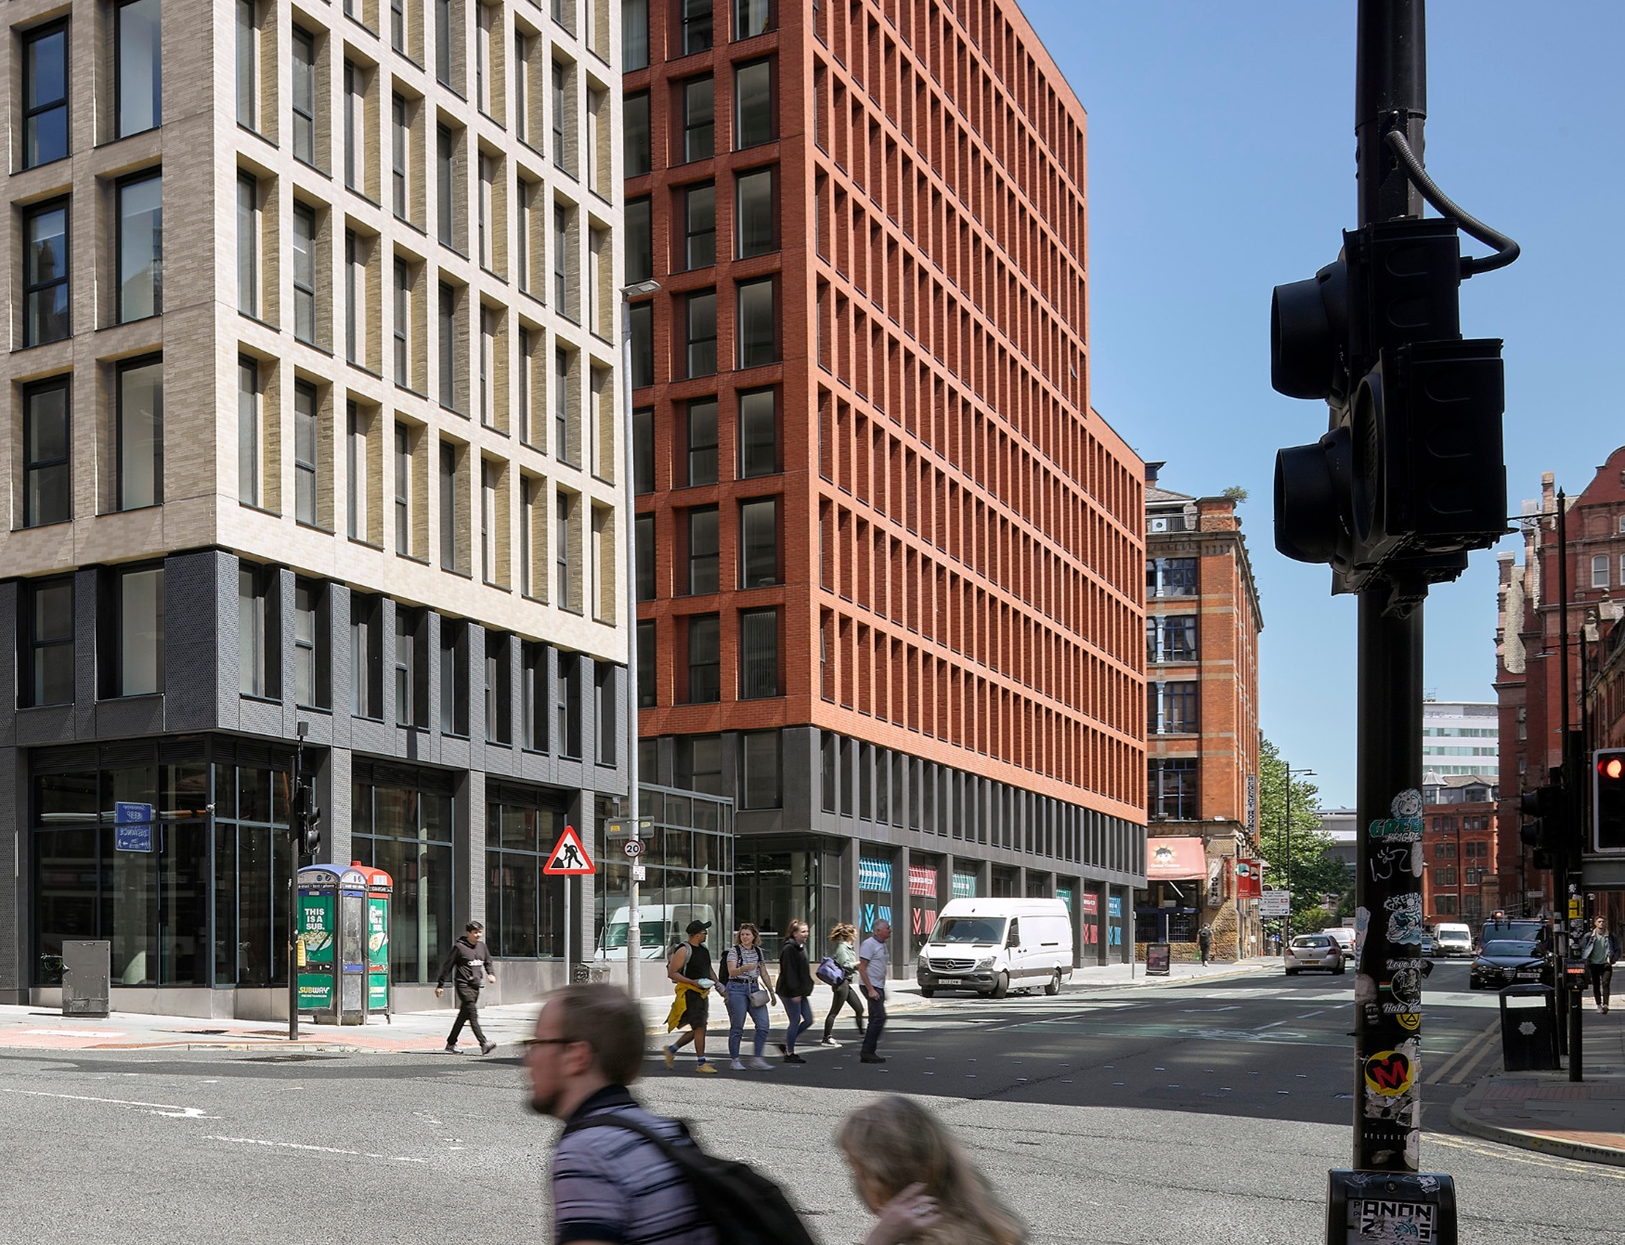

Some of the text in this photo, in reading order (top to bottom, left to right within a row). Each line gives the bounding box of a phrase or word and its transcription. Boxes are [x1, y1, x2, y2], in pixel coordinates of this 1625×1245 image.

[626, 844, 640, 854] 20
[1211, 876, 1219, 898] OPEN
[305, 908, 324, 916] THIS
[298, 986, 331, 994] SUBWAY
